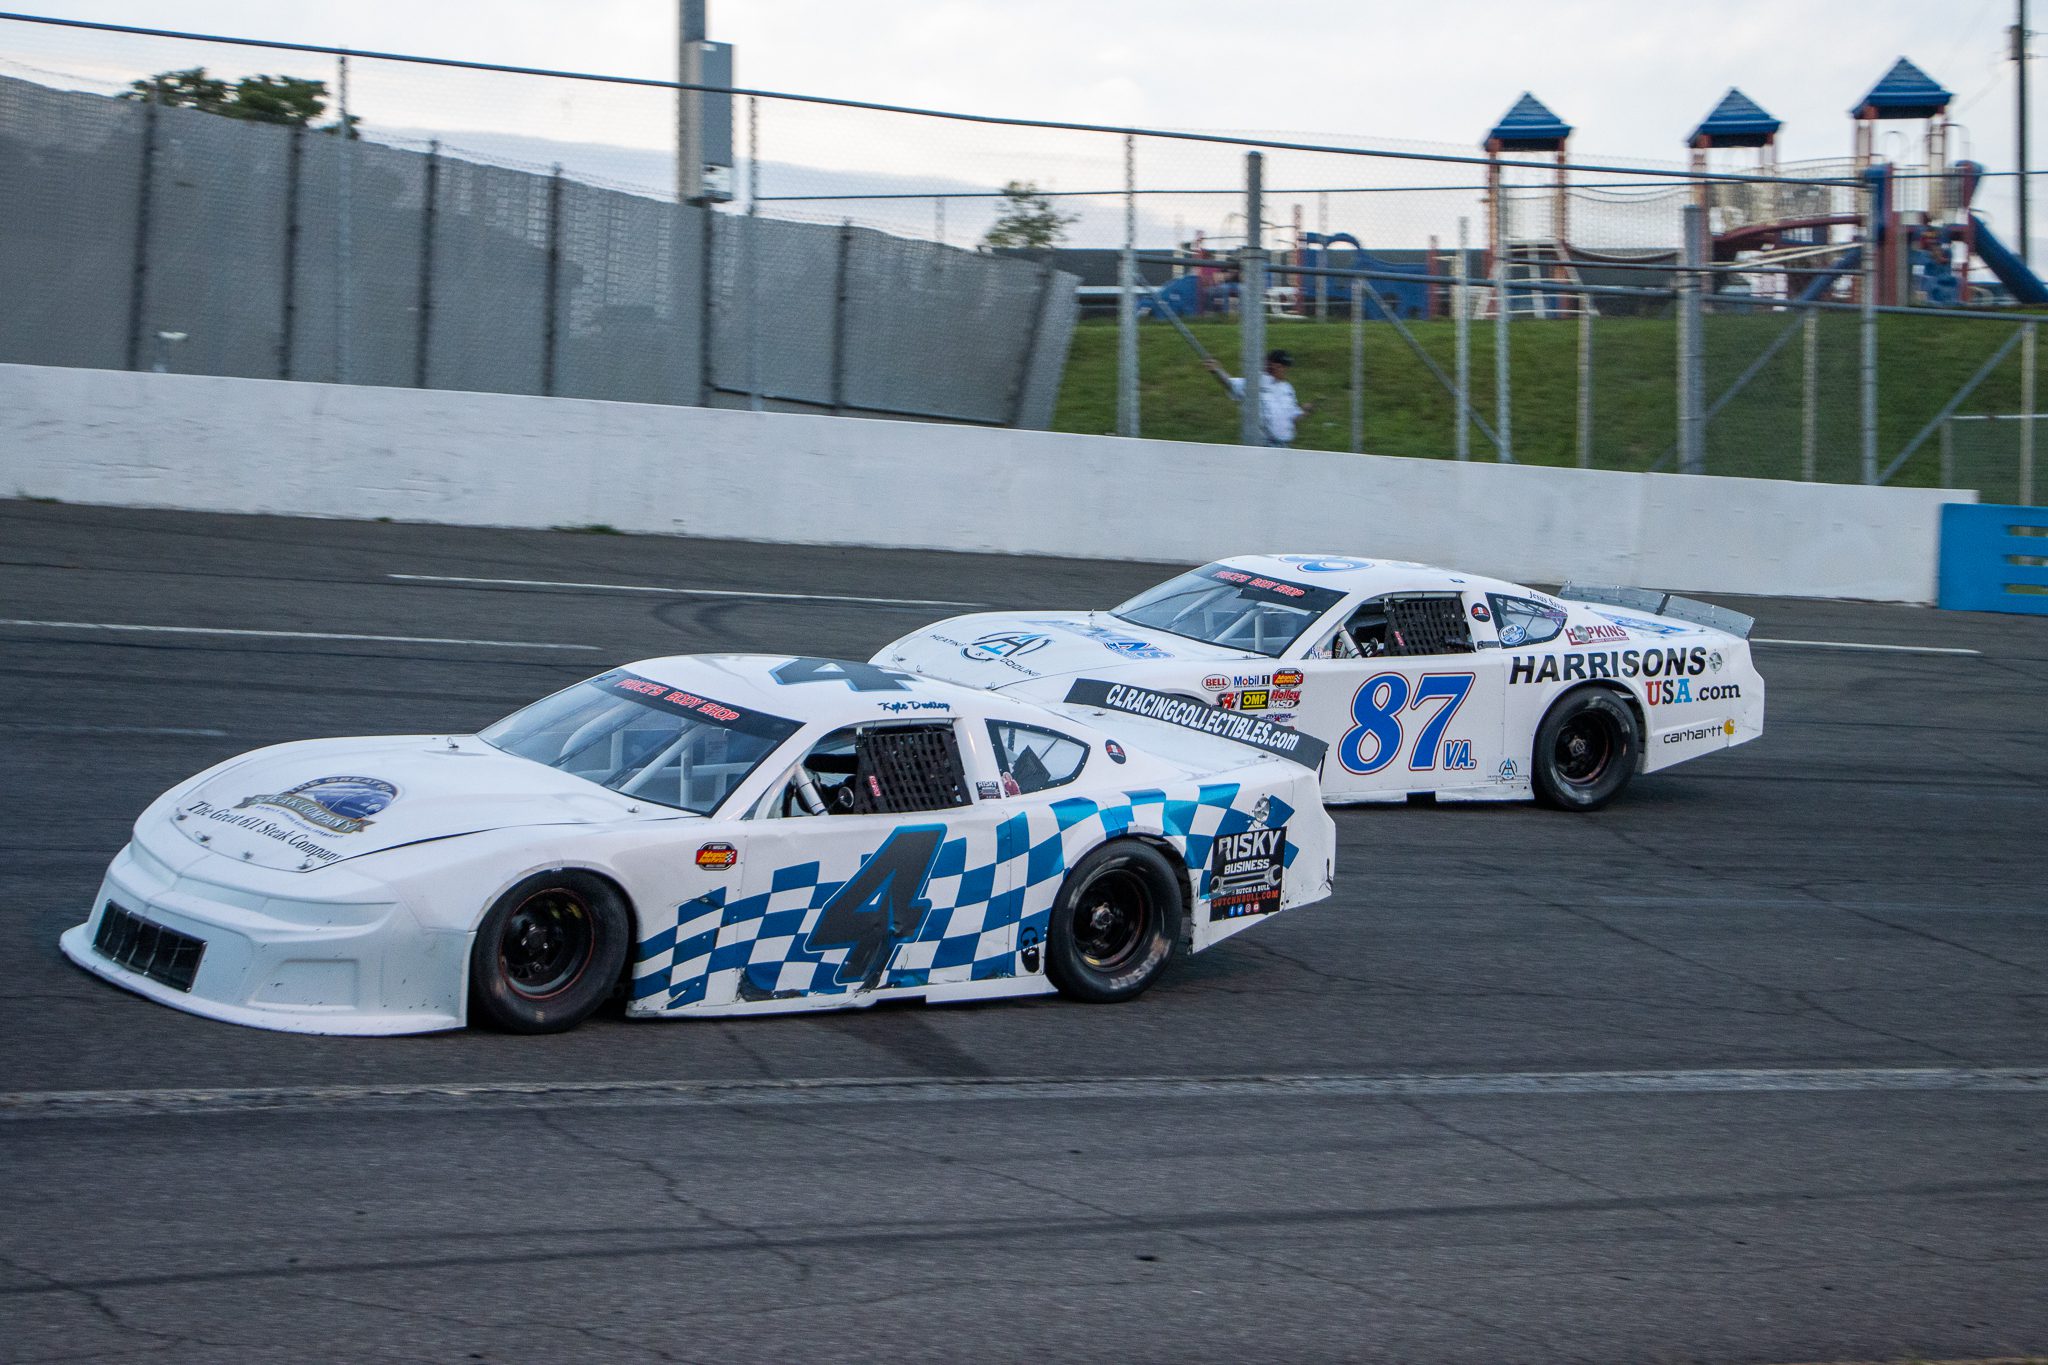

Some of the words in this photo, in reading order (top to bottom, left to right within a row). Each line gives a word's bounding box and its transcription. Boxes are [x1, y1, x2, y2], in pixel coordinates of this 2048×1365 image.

[1249, 578, 1279, 590] BODY
[1273, 584, 1305, 597] SHOP
[1529, 591, 1548, 603] Jesus
[1548, 597, 1568, 613] Saves
[1564, 625, 1627, 645] HPKINS
[1509, 647, 1706, 684] HARRISONS
[1206, 678, 1227, 686] BELL
[1234, 675, 1260, 686] Mobil
[614, 678, 669, 697] PRICE'S
[664, 691, 705, 708] BODY
[698, 702, 740, 721] SHOP
[1243, 695, 1266, 705] OMP
[1270, 689, 1300, 701] Holley
[1646, 678, 1693, 706] USA
[1696, 683, 1741, 701] .com
[1269, 699, 1296, 708] MSD
[1106, 684, 1300, 751] CLRACINGCOLLECTIBLES.com
[1338, 671, 1476, 775] 87
[1663, 725, 1723, 744] carhartt
[1443, 740, 1477, 770] VA.
[978, 781, 998, 789] RISKY
[188, 801, 210, 816] The
[210, 808, 241, 824] Great
[238, 816, 261, 830] 611
[258, 822, 293, 841] Steak
[288, 834, 343, 863] Company
[1218, 830, 1281, 861] RISKY
[1224, 859, 1270, 875] BUSINESS
[1235, 887, 1252, 895] BUTCH
[803, 823, 947, 997] 4
